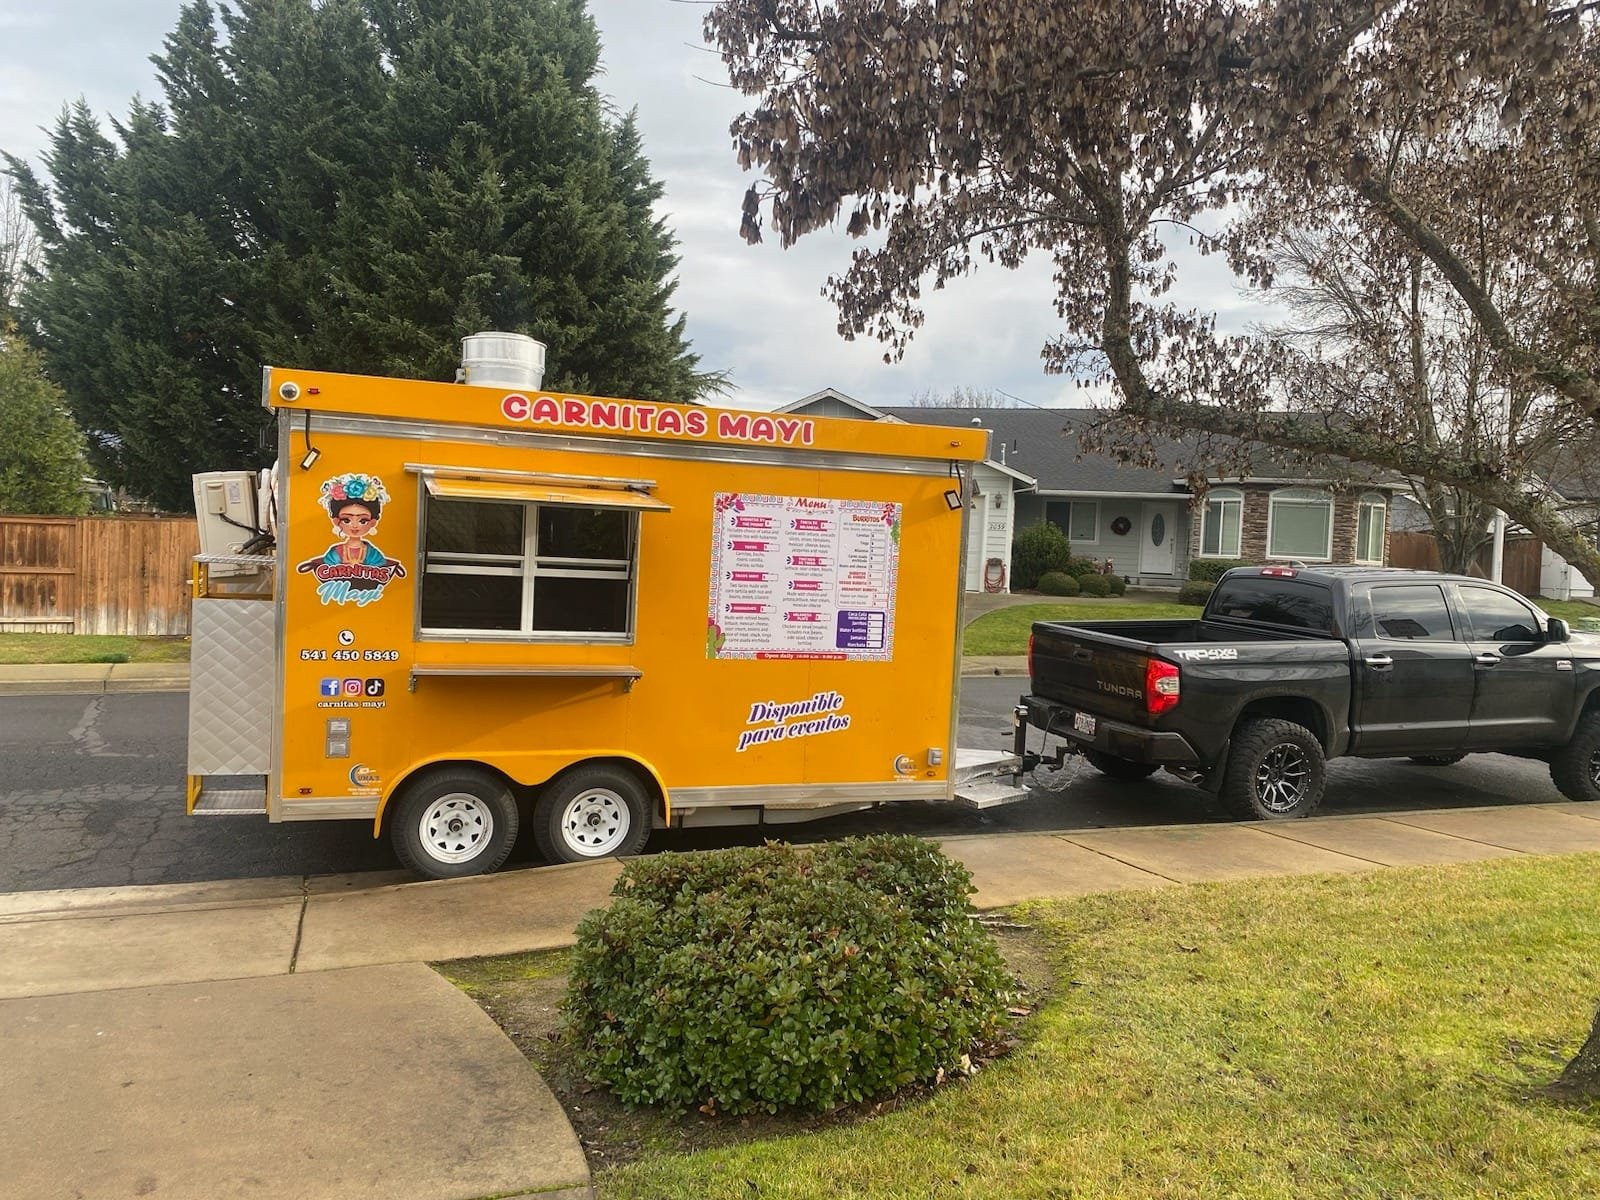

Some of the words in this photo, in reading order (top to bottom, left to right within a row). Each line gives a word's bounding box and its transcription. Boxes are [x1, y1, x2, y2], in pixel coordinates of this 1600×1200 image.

[502, 395, 706, 435] CARNITAS
[718, 414, 814, 444] MAYI
[795, 498, 827, 509] Menu
[317, 563, 390, 583] CARNITAS
[318, 582, 382, 606] Mayi
[300, 650, 328, 660] 541
[332, 650, 360, 661] 450
[364, 650, 400, 661] 5849
[1097, 680, 1143, 700] TUNDRA
[317, 699, 359, 708] carnitas
[362, 699, 386, 710] mayi
[748, 692, 843, 723] Disponible
[738, 724, 785, 751] para
[788, 714, 850, 738] eventos
